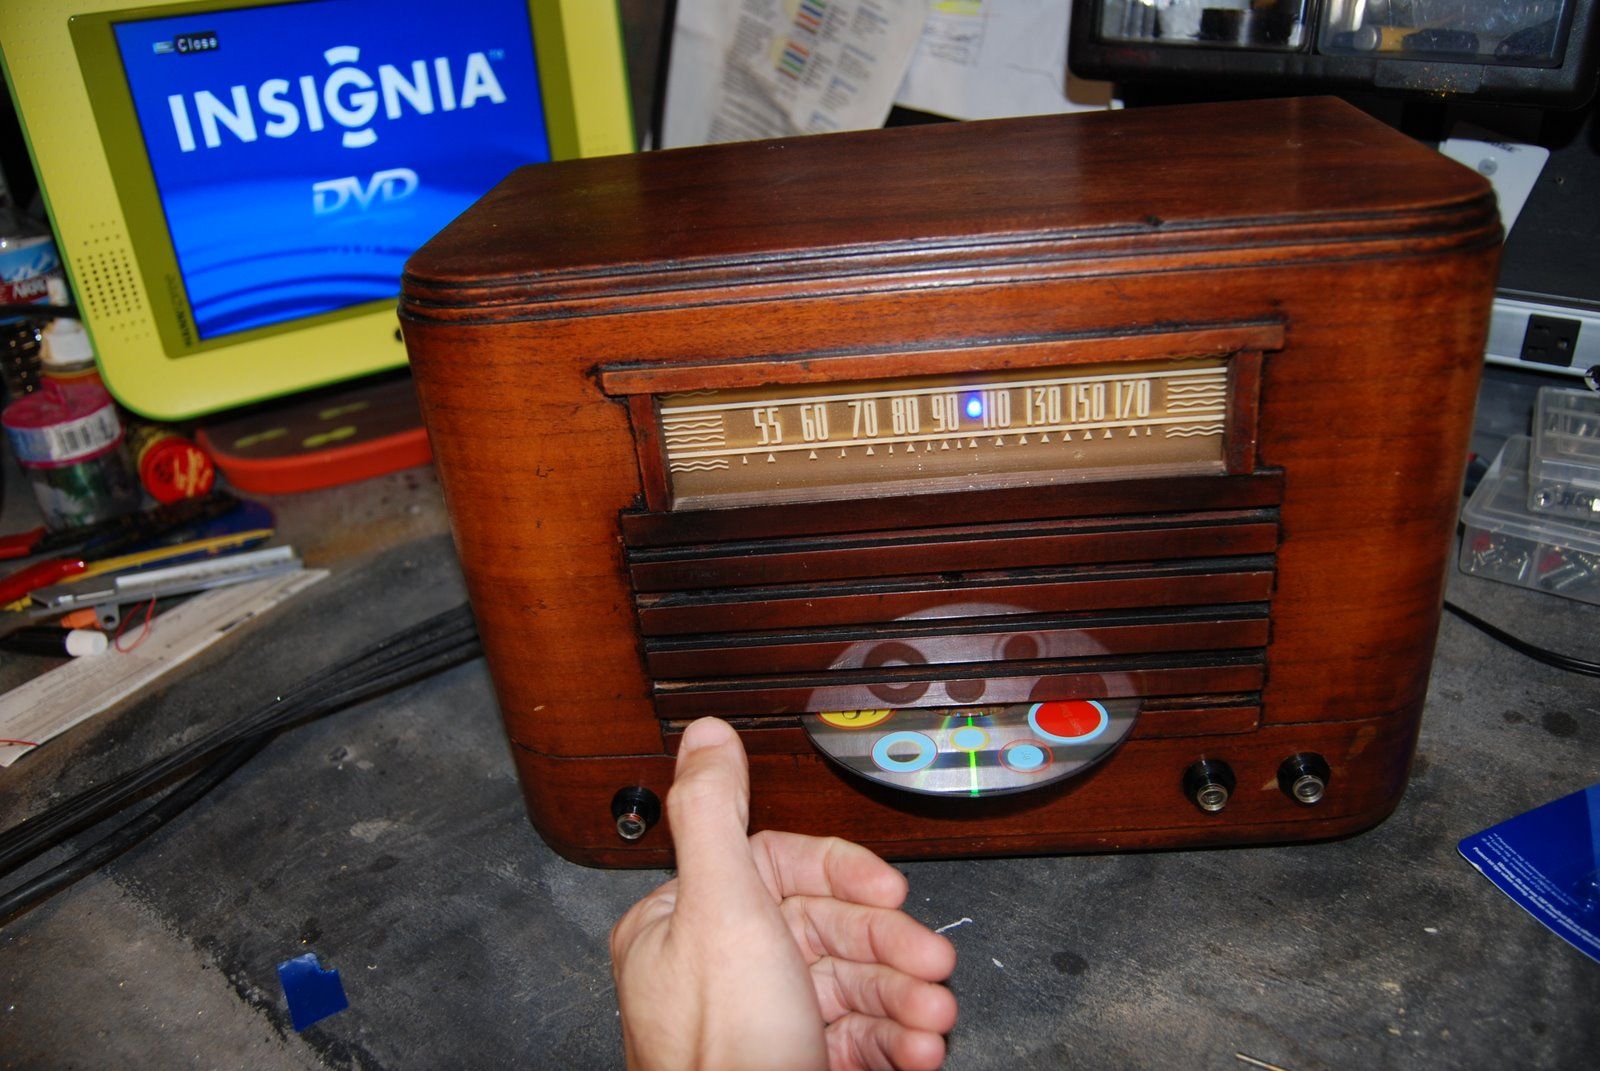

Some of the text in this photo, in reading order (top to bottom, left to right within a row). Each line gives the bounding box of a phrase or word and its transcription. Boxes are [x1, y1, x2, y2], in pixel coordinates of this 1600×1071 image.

[178, 36, 217, 52] Close
[168, 47, 507, 152] INSIGNIA
[312, 168, 419, 215] DVD
[752, 379, 1150, 445] 55 60 70 80 90 110 130 150 170
